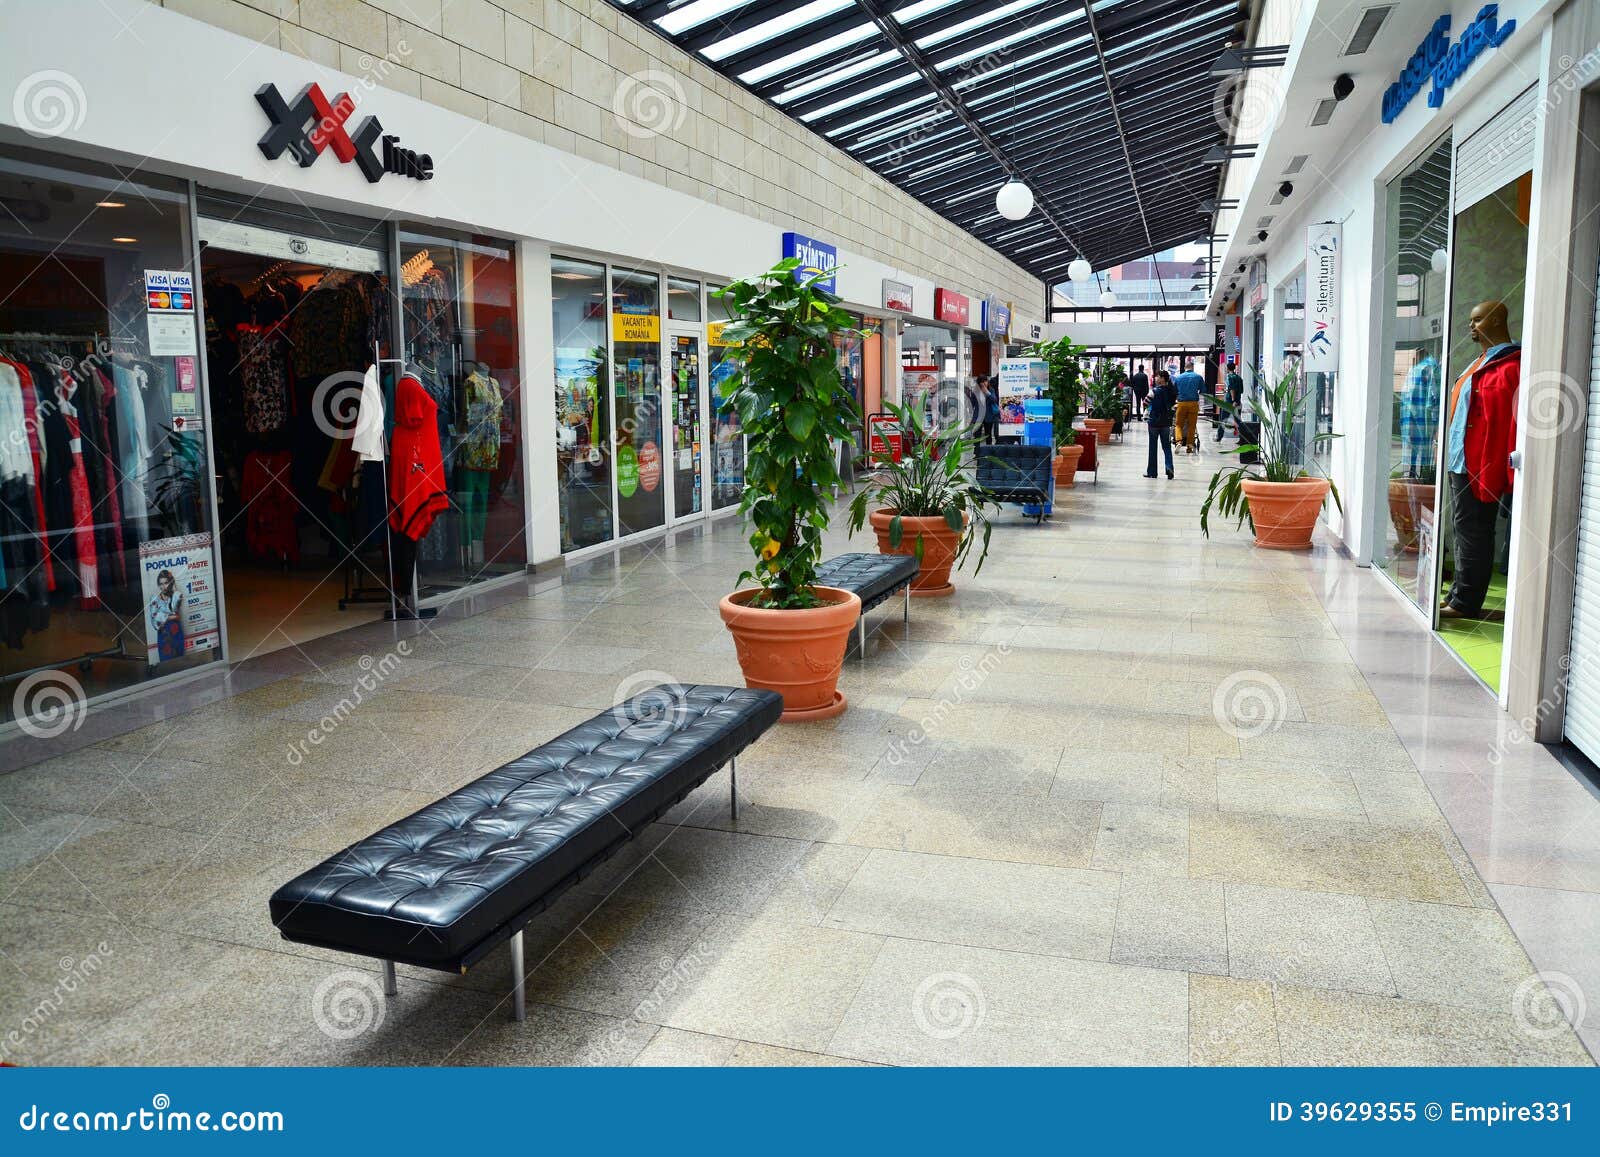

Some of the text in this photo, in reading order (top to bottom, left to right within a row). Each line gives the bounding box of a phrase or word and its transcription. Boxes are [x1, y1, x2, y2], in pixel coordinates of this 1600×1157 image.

[149, 275, 168, 285] VISA
[172, 276, 190, 286] VISA
[1316, 255, 1329, 313] Silentium
[145, 556, 189, 572] POPULAR
[186, 582, 192, 594] 1
